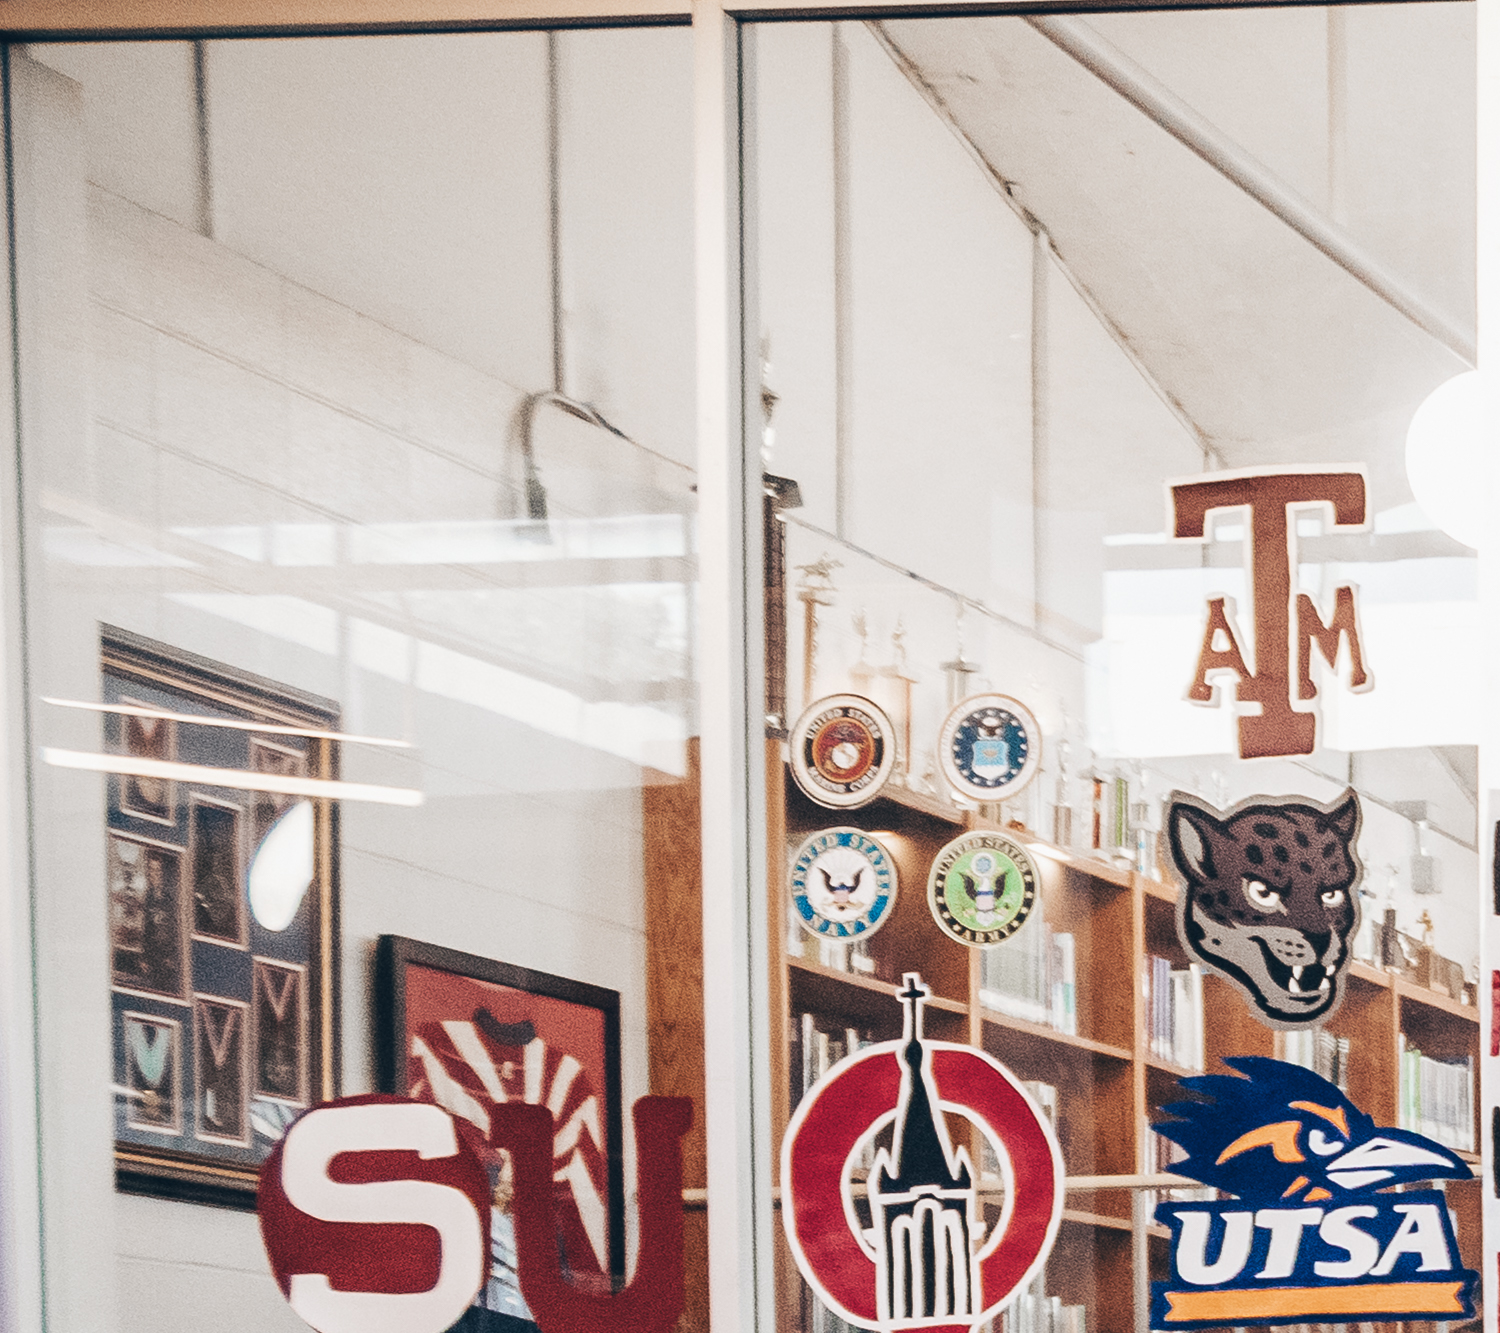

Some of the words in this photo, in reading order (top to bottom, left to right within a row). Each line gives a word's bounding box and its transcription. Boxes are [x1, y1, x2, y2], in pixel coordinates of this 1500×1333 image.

[938, 837, 983, 875] UNITED
[984, 837, 1031, 874] STATES
[961, 920, 1017, 944] ARMY
[1172, 1206, 1456, 1286] UTSA
